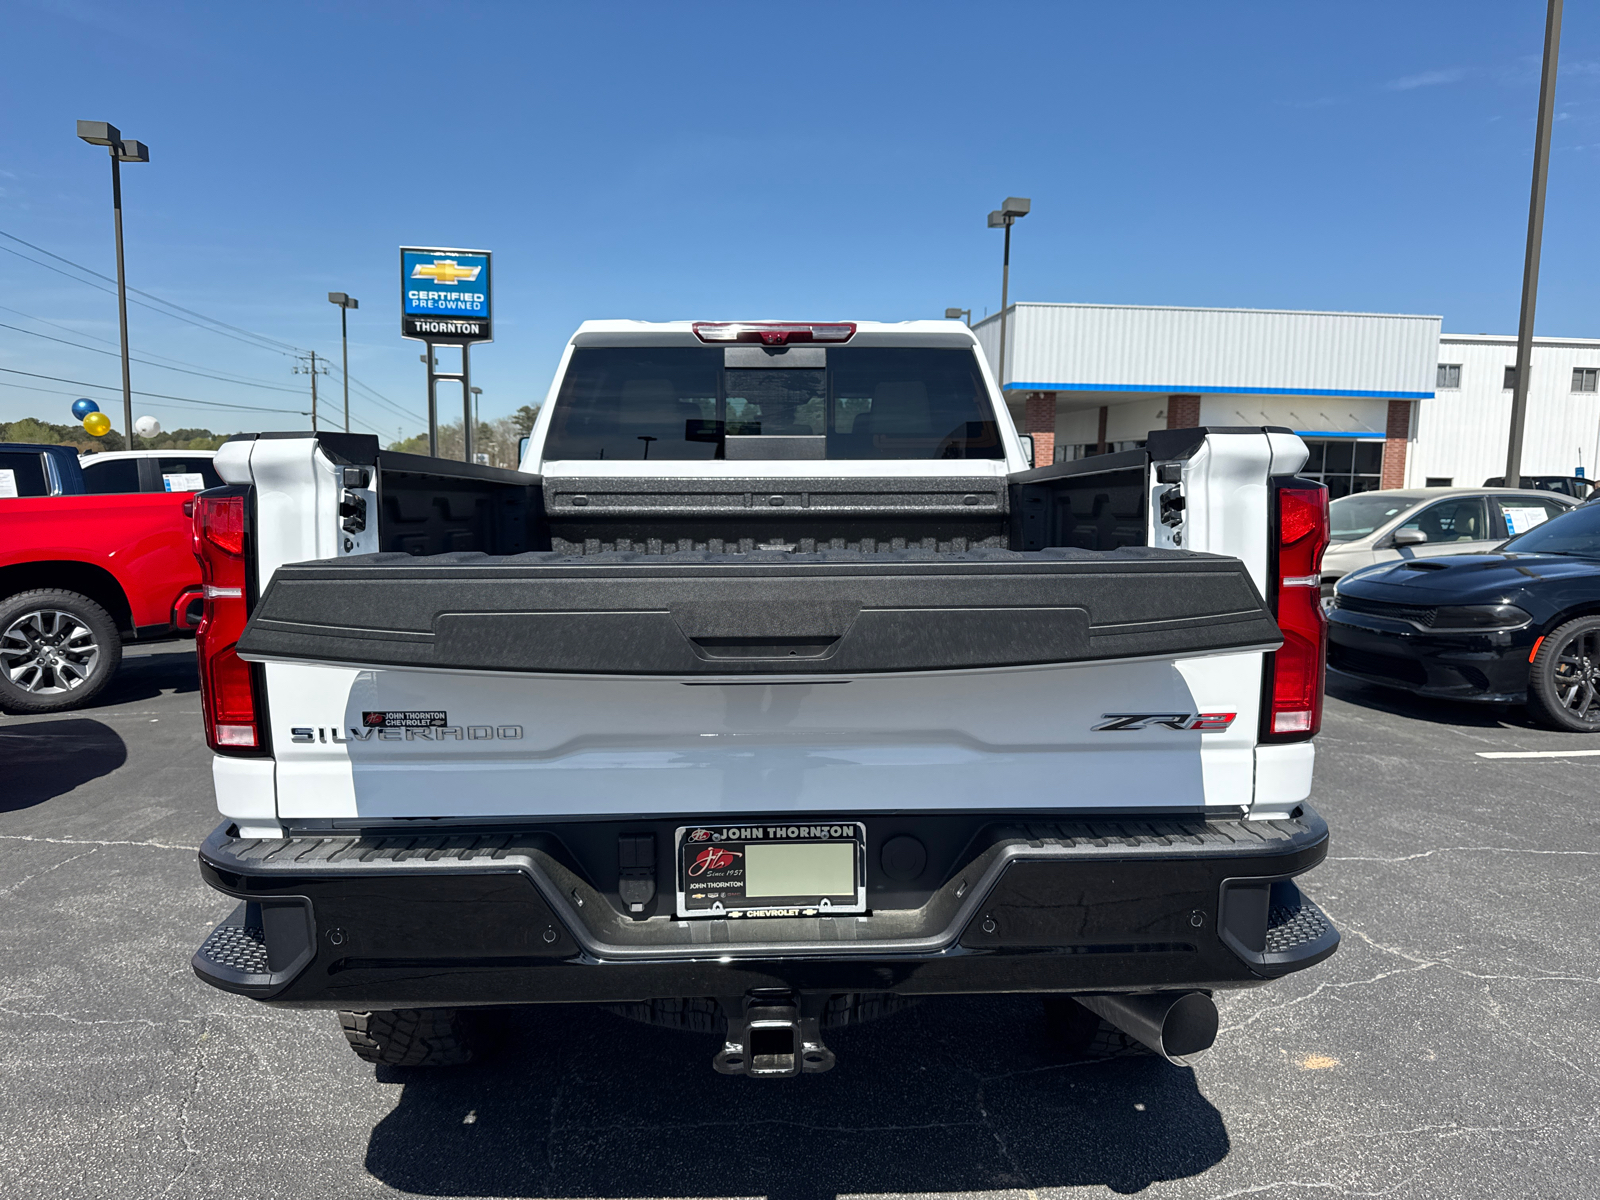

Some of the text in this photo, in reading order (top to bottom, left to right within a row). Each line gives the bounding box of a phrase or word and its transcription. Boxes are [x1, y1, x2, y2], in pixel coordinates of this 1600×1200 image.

[409, 291, 484, 302] CERTIFIED
[413, 300, 481, 310] PRE-OWNED
[415, 322, 479, 334] THORNTON
[385, 712, 445, 720] JOHN THORNTON
[1090, 712, 1238, 732] ZR2
[291, 725, 523, 743] SILVERADO
[720, 826, 854, 839] JOHN THORNTON
[746, 908, 799, 918] CHEVROLET
